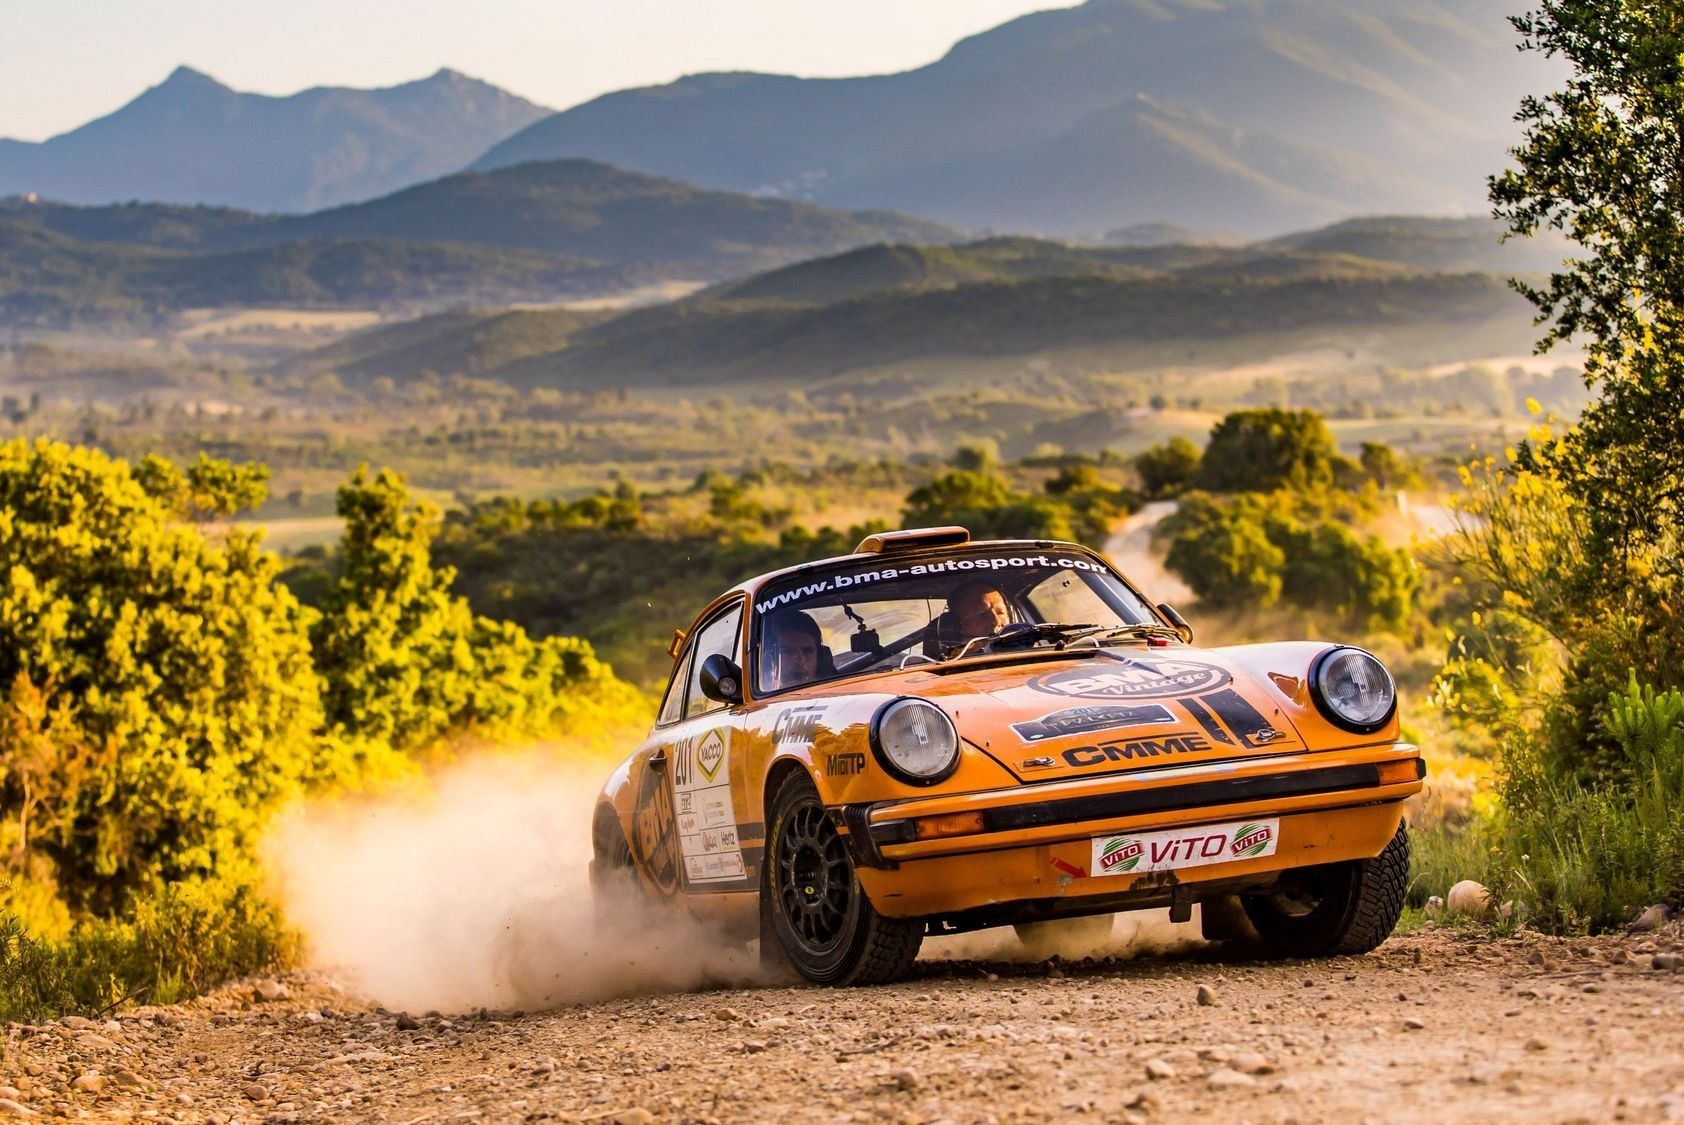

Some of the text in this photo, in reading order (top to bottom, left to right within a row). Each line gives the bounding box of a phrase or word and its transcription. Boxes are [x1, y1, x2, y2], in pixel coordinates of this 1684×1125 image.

[1051, 662, 1209, 695] BMA
[1103, 671, 1206, 696] Vintage
[675, 736, 693, 786] 201
[701, 742, 721, 761] YACCO
[721, 831, 735, 845] Hertz
